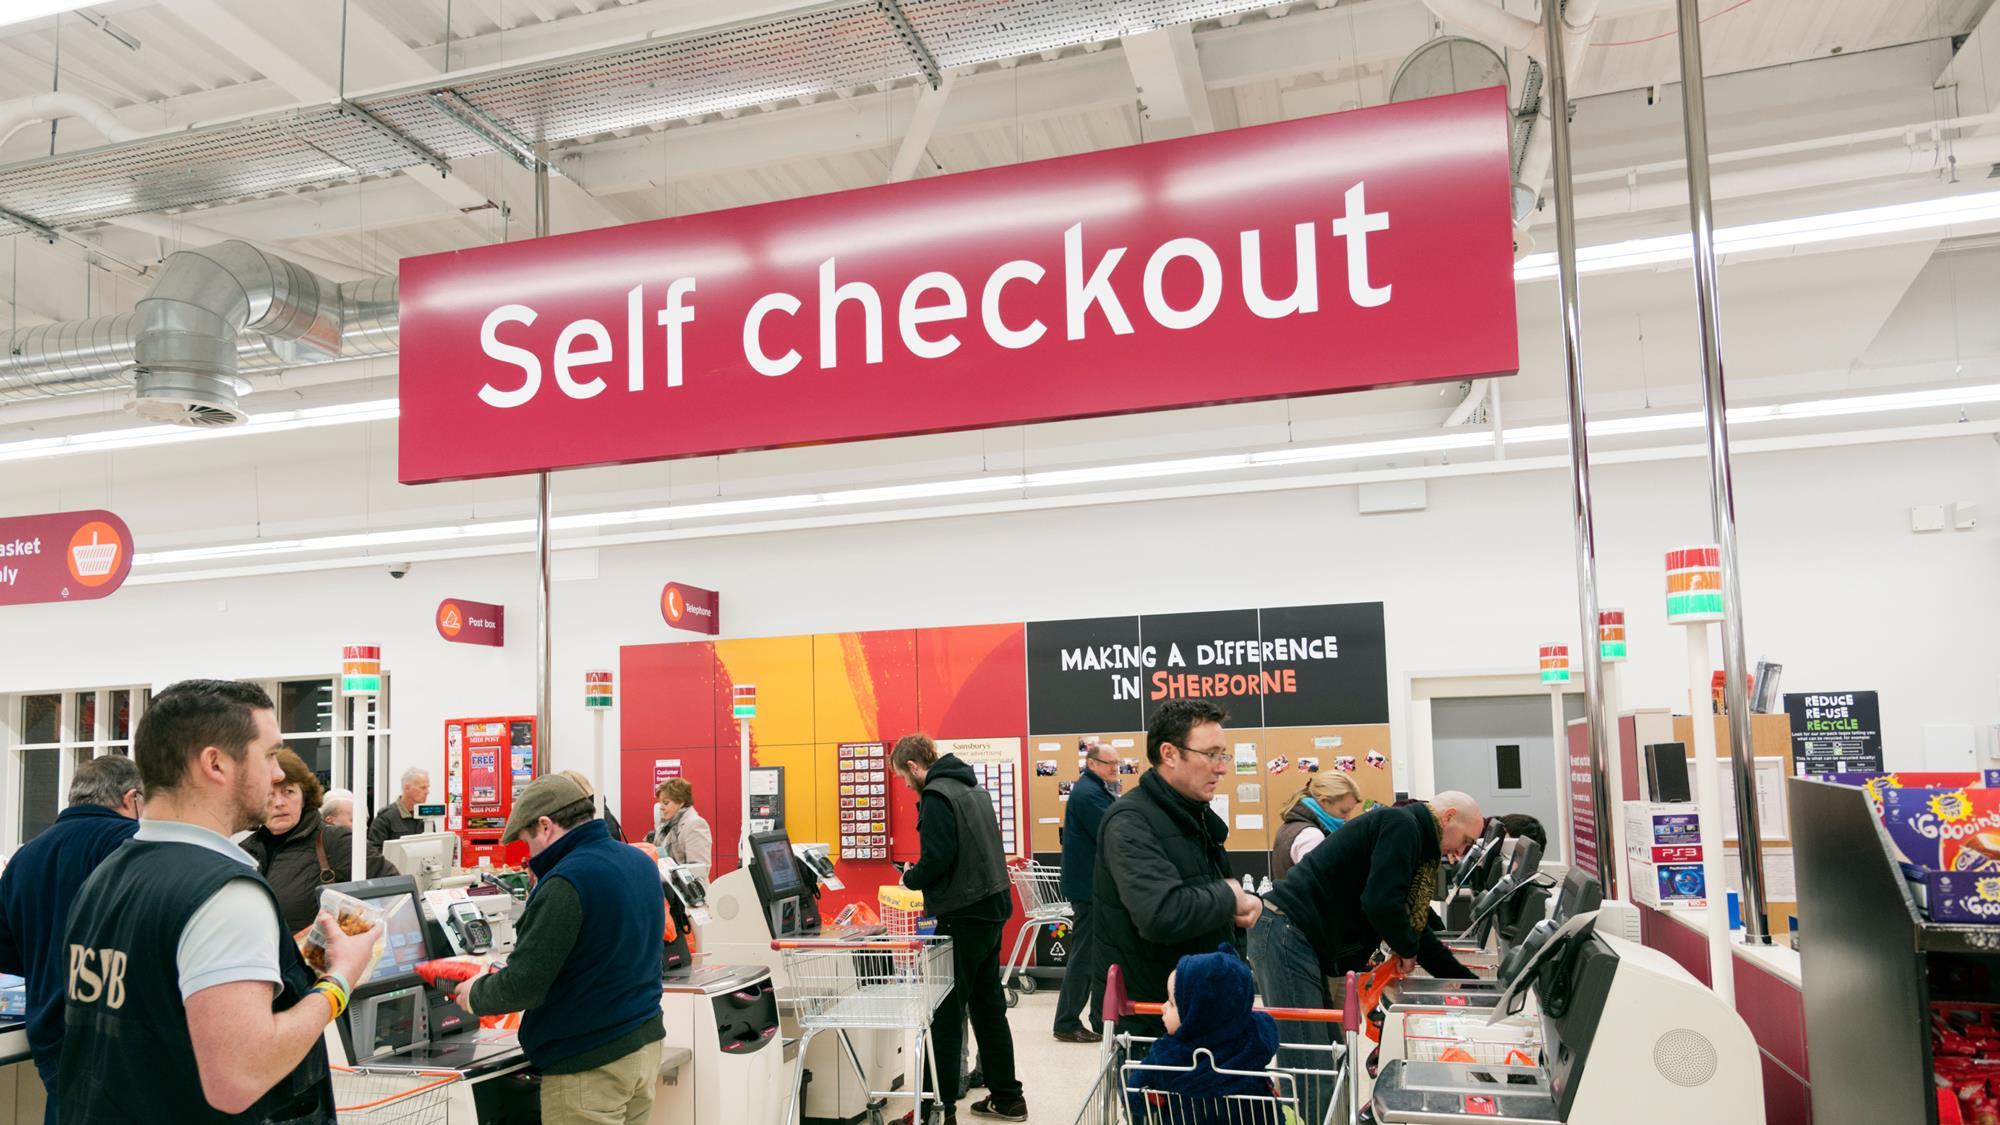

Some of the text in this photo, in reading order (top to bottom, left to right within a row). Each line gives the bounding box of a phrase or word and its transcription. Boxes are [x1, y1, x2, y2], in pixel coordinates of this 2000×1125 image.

[477, 179, 1393, 408] Self checkout
[685, 603, 712, 617] Telephone
[468, 616, 496, 629] Post box
[1061, 635, 1338, 671] MAKING A DIFFERENCE
[1112, 669, 1297, 700] IN SHERBORNE
[1805, 694, 1854, 707] REDUCE
[1806, 707, 1849, 719] RE-USE
[1807, 719, 1859, 731] RECYCLE
[953, 742, 991, 751] Sainsbury's
[472, 755, 494, 765] FREE
[1662, 848, 1697, 857] PS3
